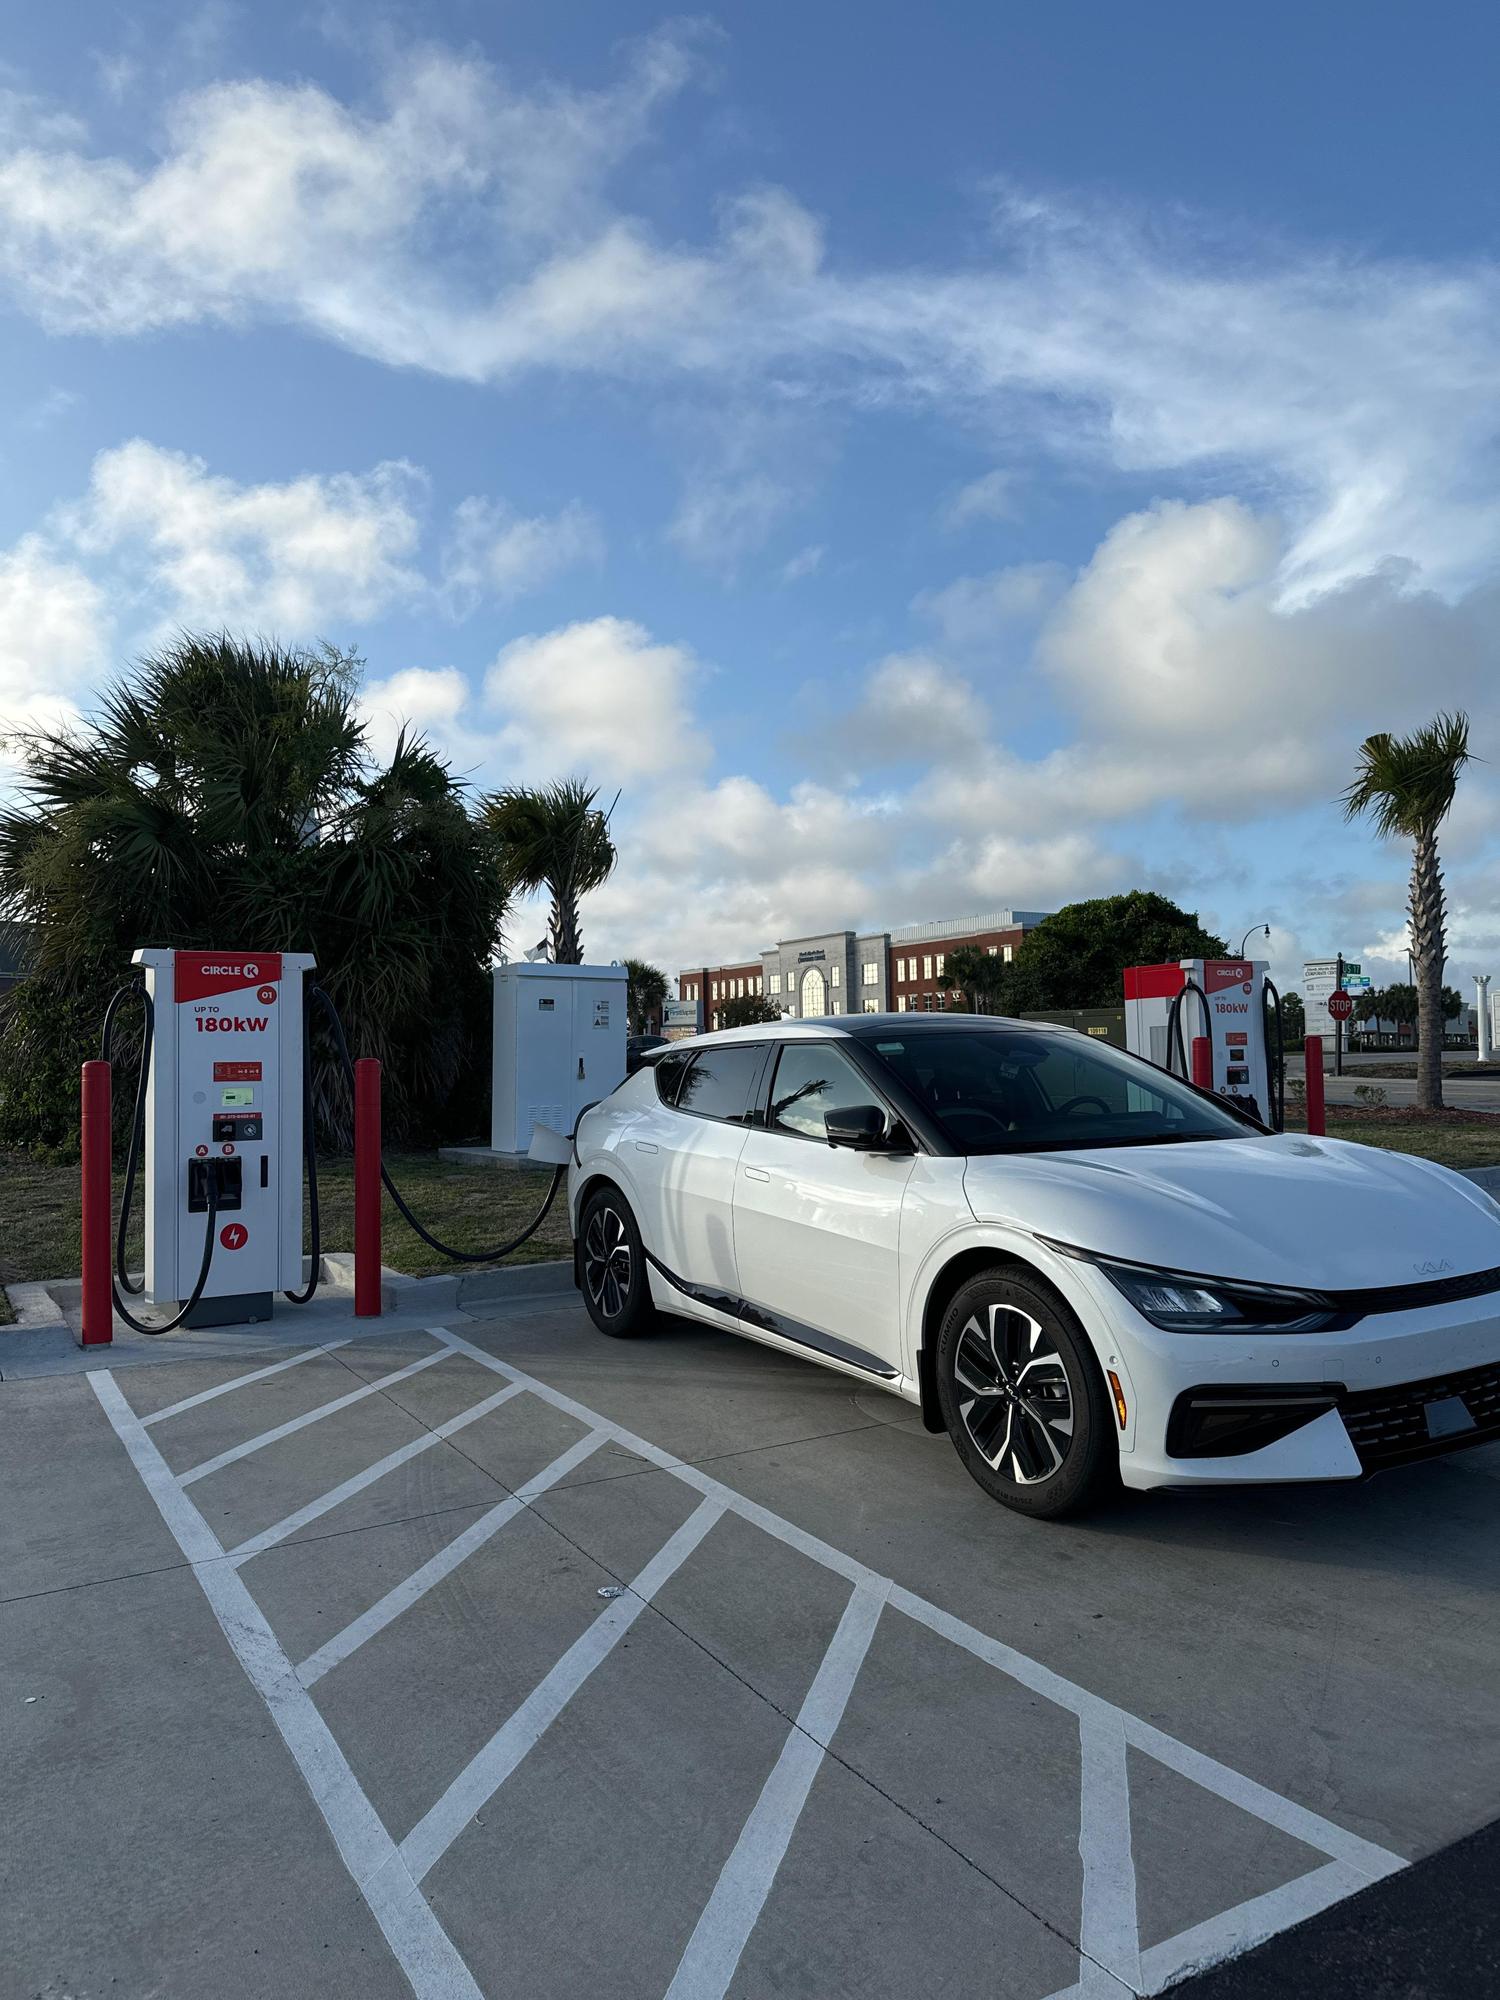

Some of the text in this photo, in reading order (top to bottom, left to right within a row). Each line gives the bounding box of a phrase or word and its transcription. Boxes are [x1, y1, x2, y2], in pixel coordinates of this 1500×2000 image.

[201, 965, 258, 978] CIRCLE K
[1216, 969, 1235, 977] CIRCLE
[1353, 965, 1360, 974] 17
[1215, 1003, 1248, 1014] 180kW
[1329, 1000, 1351, 1012] STOP
[195, 1016, 269, 1032] 180kW
[198, 1145, 232, 1154] A B
[940, 1307, 959, 1355] KUMHO
